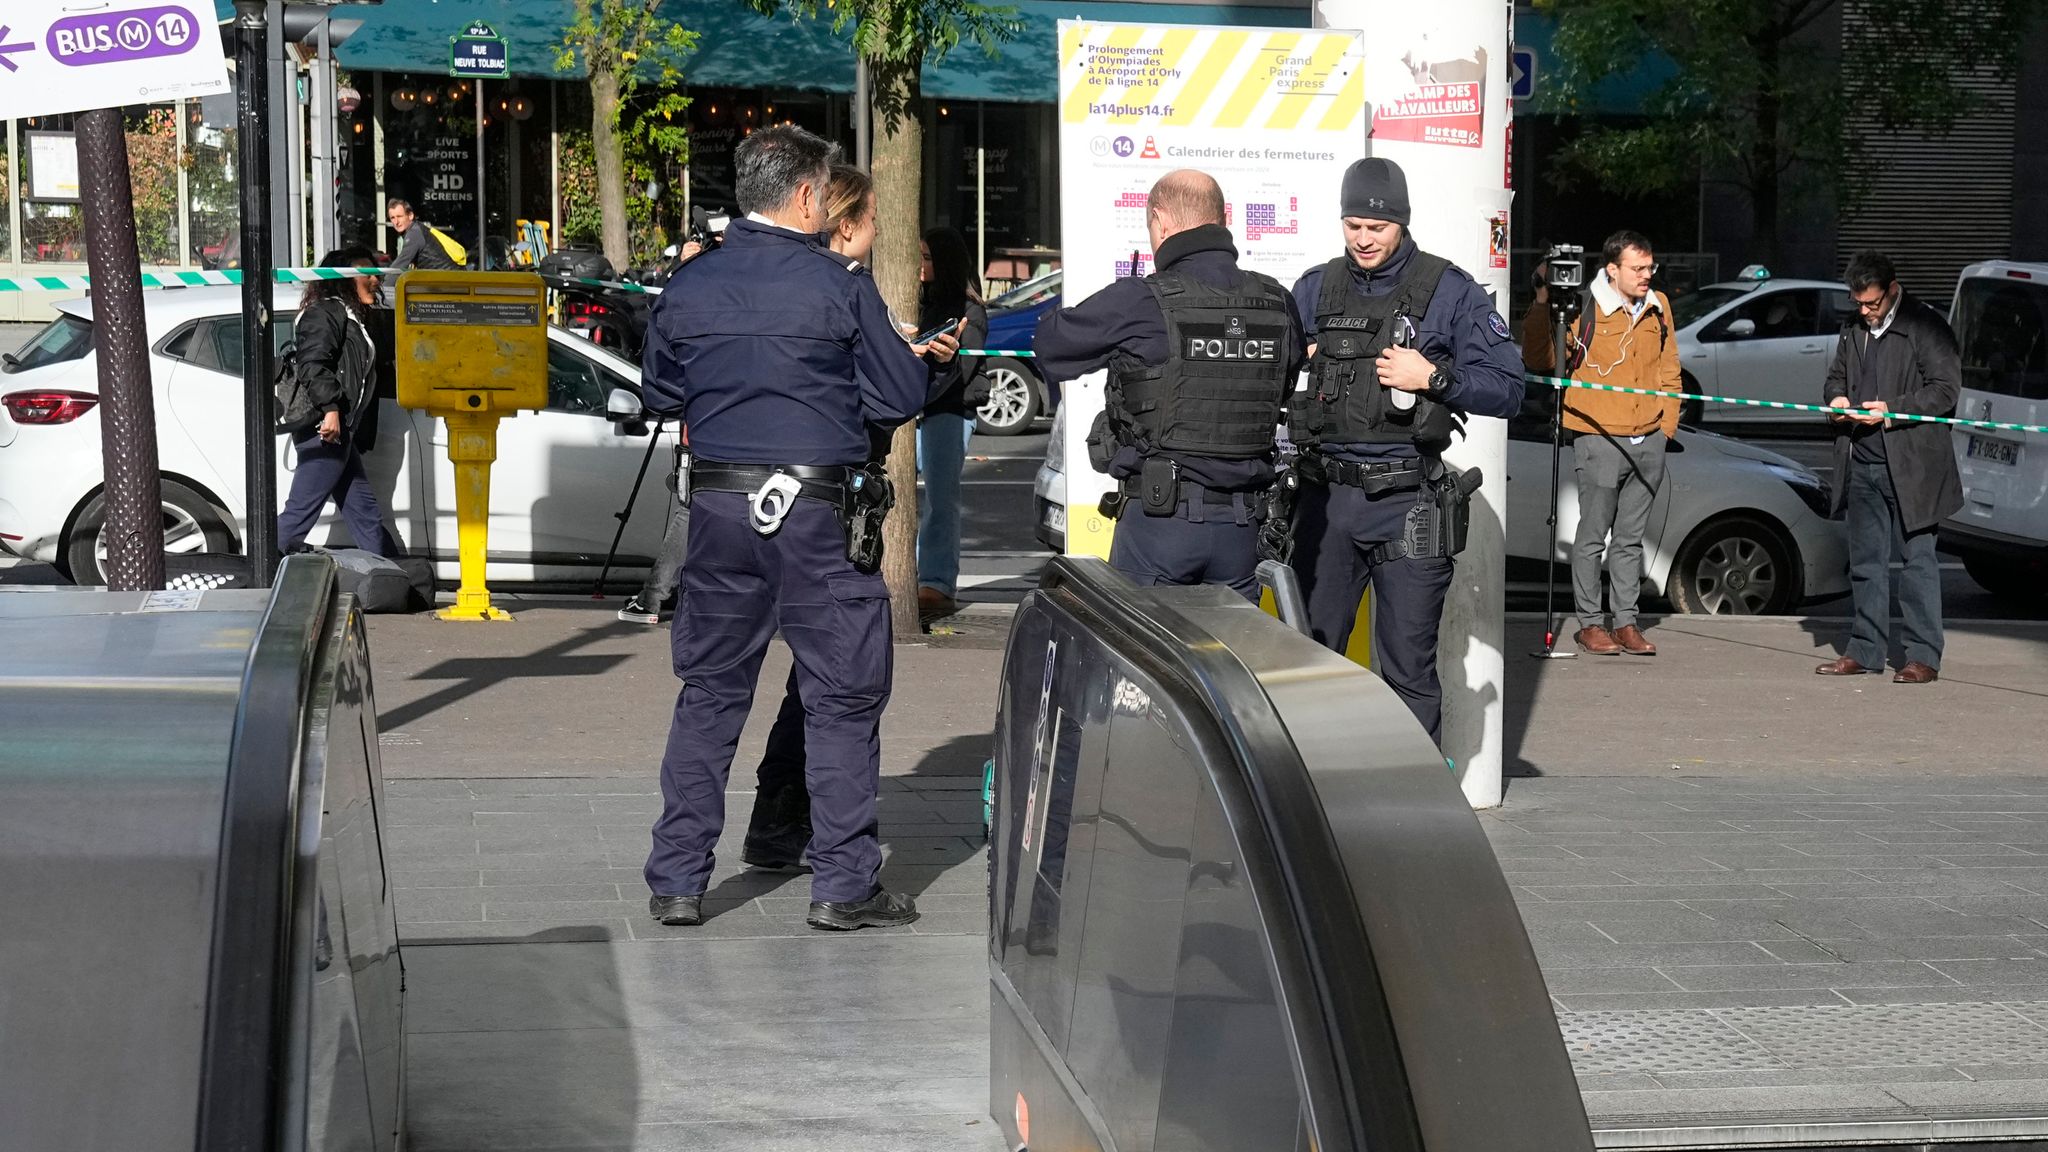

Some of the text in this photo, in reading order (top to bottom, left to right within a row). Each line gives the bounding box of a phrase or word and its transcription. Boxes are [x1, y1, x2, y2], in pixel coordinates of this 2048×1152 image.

[156, 19, 187, 42] 14
[472, 45, 487, 55] RUE
[1088, 45, 1164, 56] Prolongement
[454, 57, 505, 69] NEUVE TOLBIAC
[1088, 55, 1161, 67] d'Olympiades
[1275, 55, 1312, 66] Grand
[1088, 66, 1181, 79] à Aéroport d'Orly
[1269, 66, 1300, 77] Paris
[1088, 76, 1159, 88] de la ligne 14
[1277, 79, 1325, 90] express
[1447, 84, 1471, 98] DES
[1088, 103, 1175, 117] la14plus14.fr
[435, 137, 460, 147] LIVE
[1115, 140, 1131, 153] 14
[1167, 146, 1335, 161] Calendrier des fermetures
[440, 163, 455, 172] ON
[433, 174, 464, 190] HD
[424, 192, 473, 201] SCREENS
[1328, 318, 1367, 328] POLICE
[1190, 339, 1275, 359] POLICE
